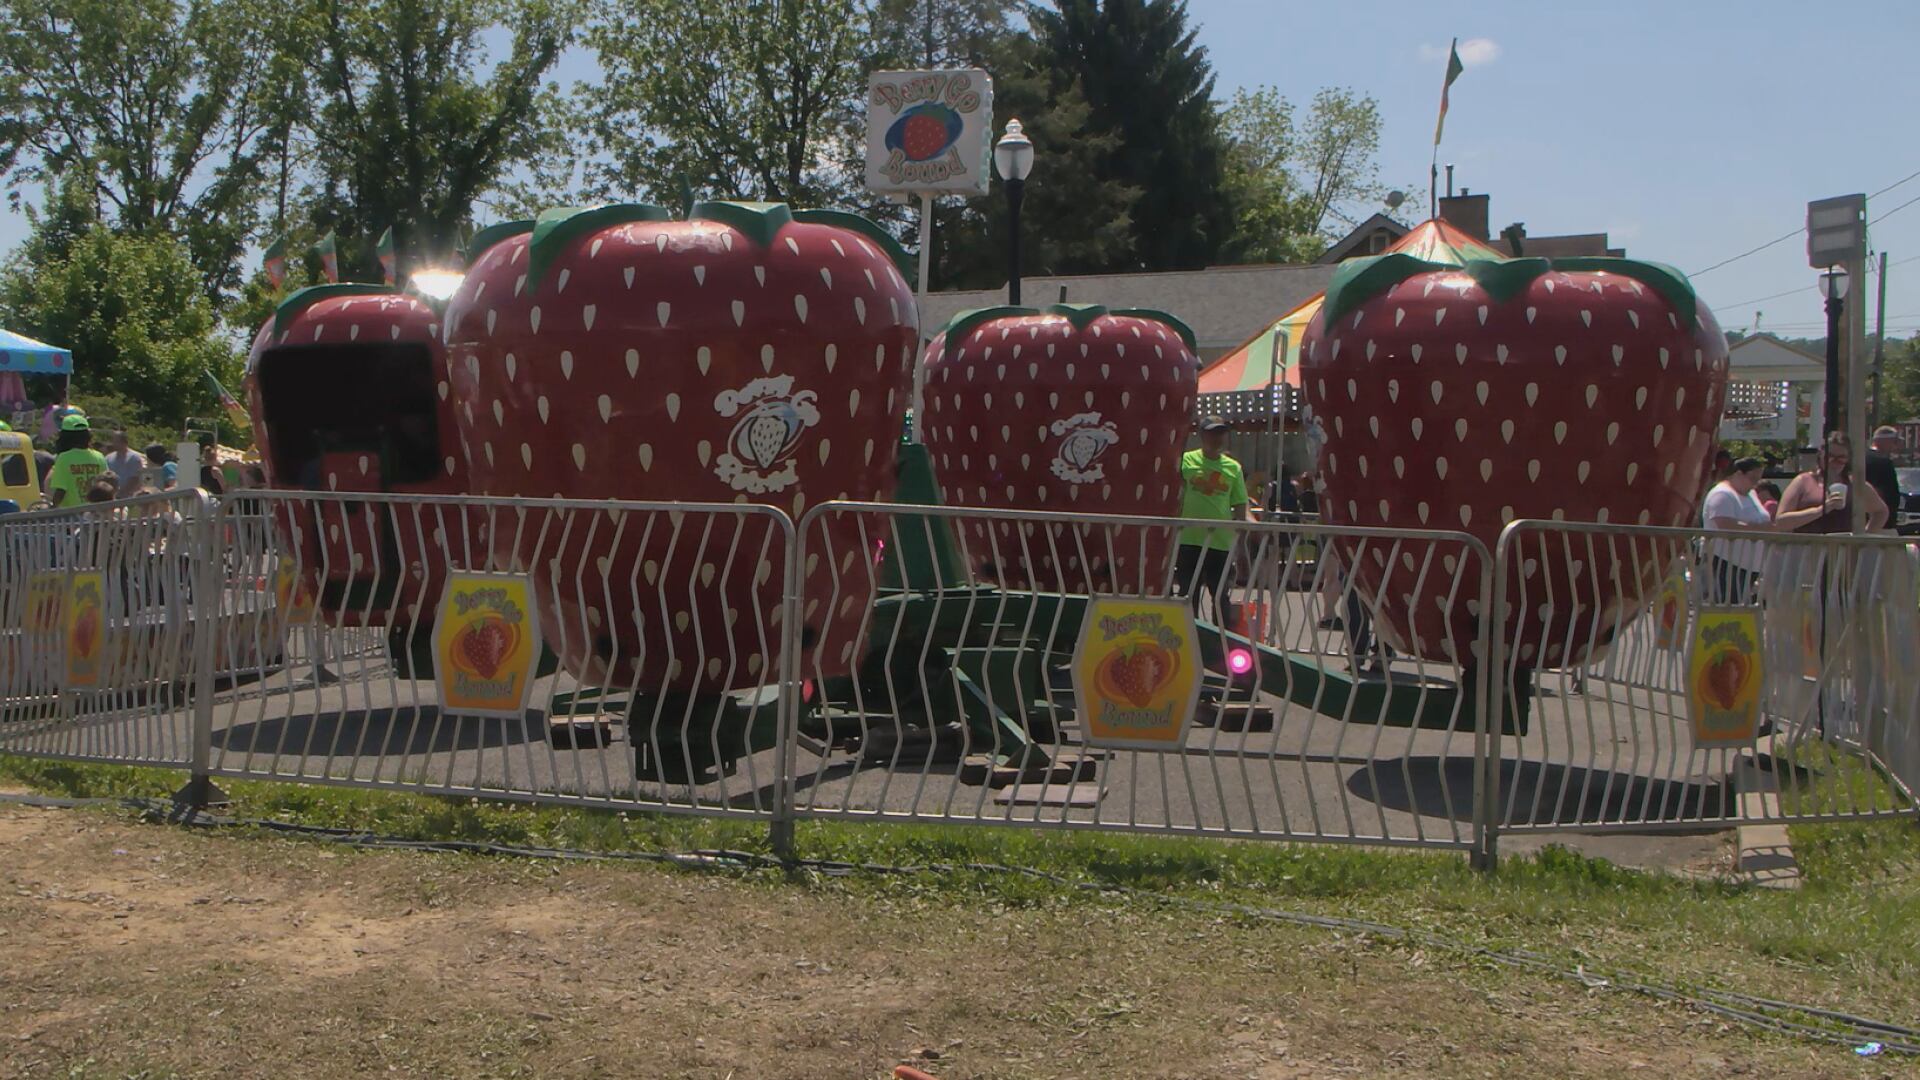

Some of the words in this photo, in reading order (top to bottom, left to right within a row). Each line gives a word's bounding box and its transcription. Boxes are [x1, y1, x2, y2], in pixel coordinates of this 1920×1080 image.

[873, 75, 946, 115] Berry
[945, 74, 981, 113] Go
[879, 147, 967, 185] Round
[1098, 612, 1163, 641] Berry
[1098, 699, 1176, 731] Round
